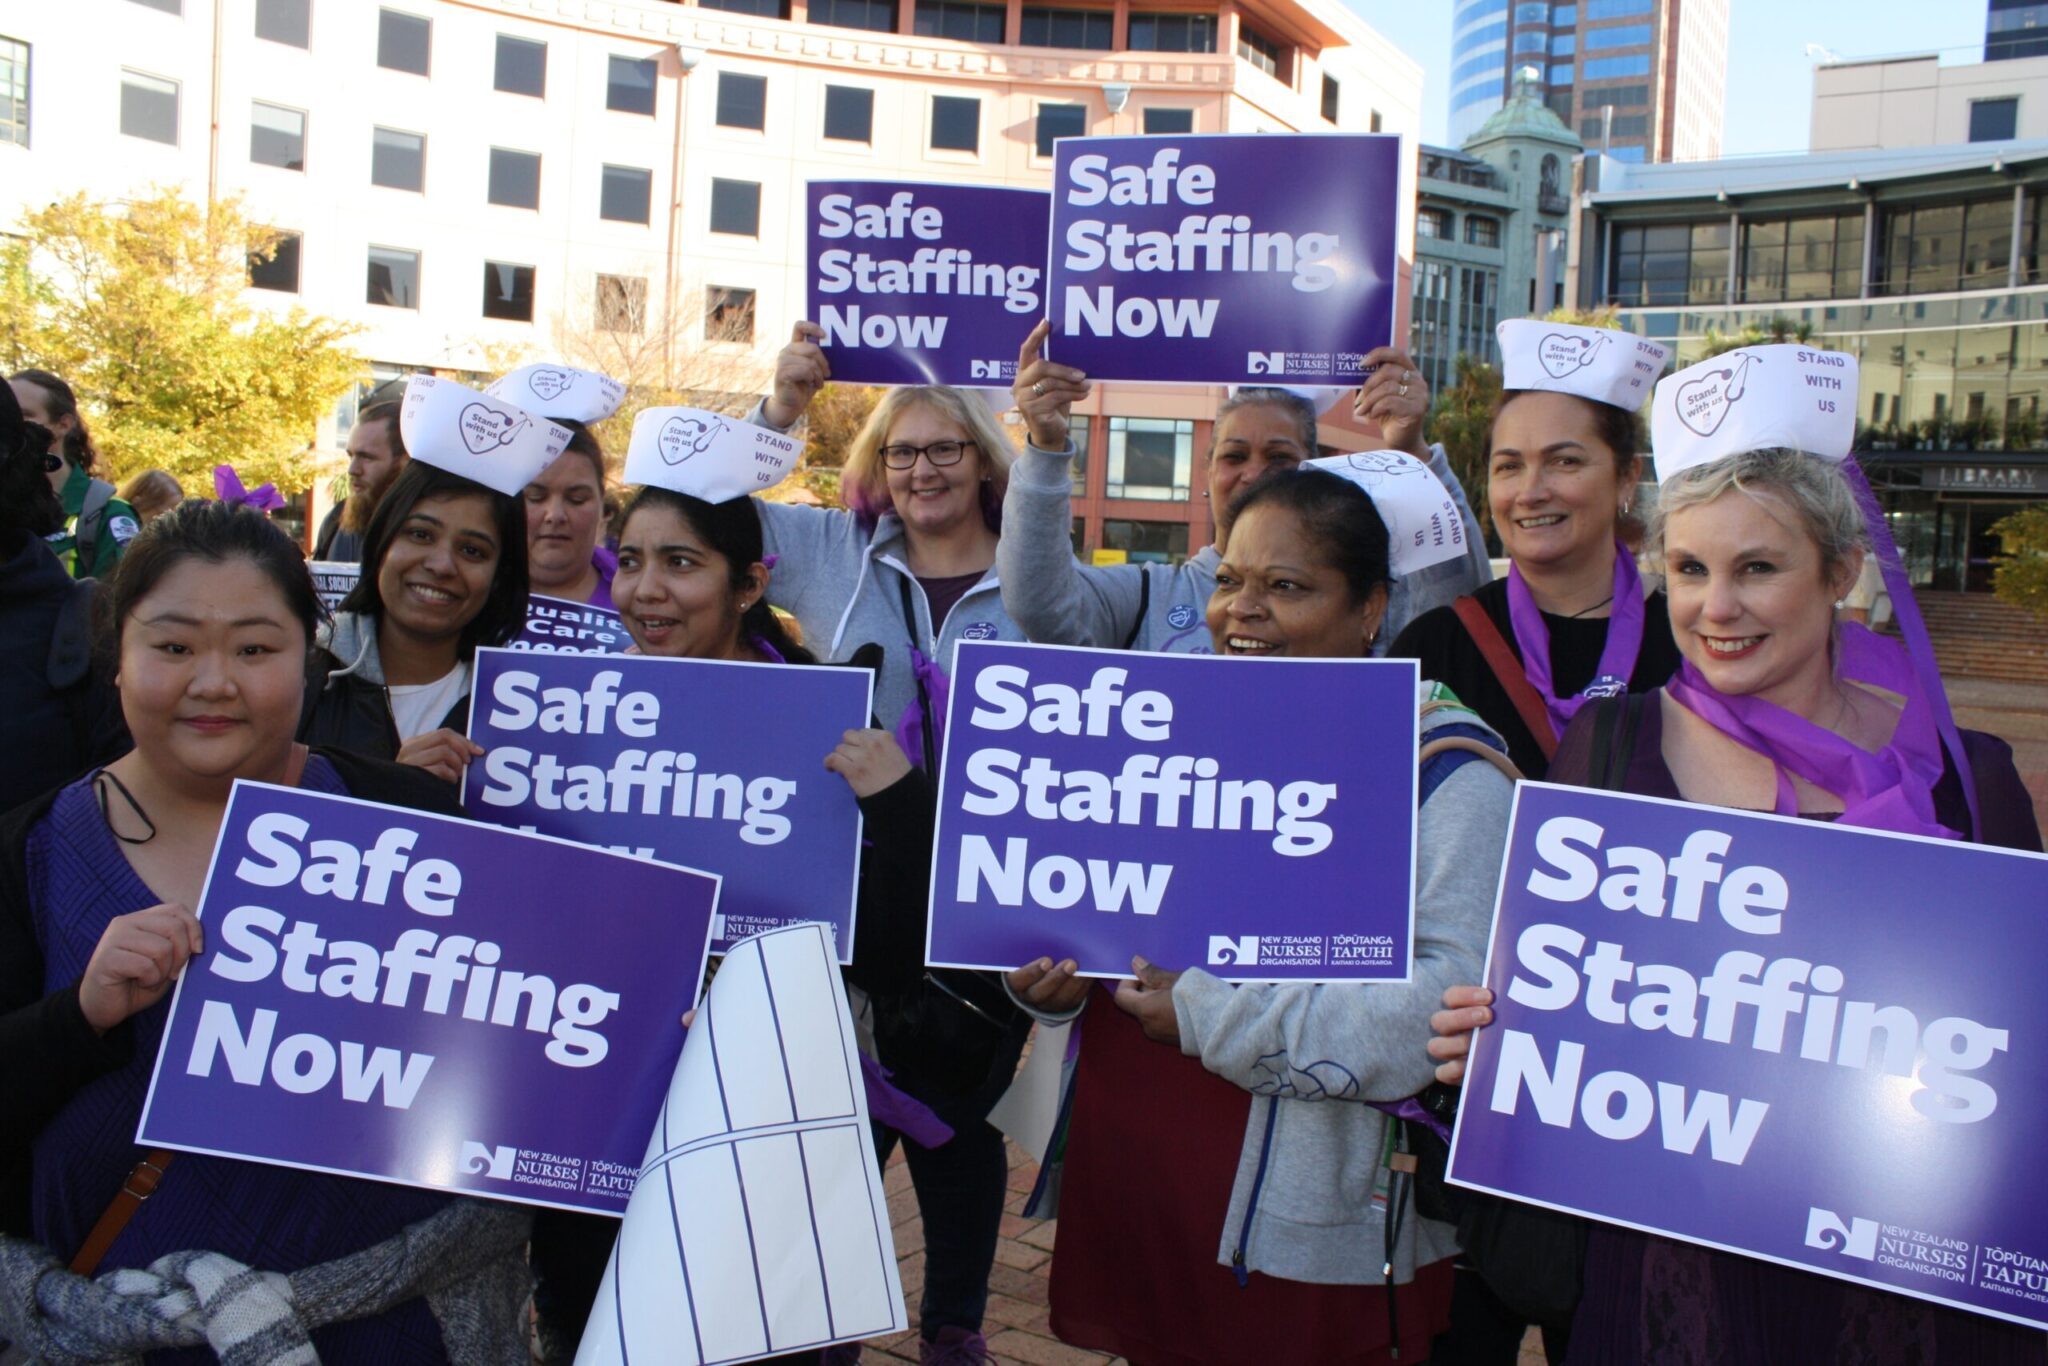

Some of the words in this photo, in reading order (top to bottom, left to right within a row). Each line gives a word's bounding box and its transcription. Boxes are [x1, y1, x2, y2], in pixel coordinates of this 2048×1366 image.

[1067, 148, 1216, 206] Safe
[818, 192, 943, 239] Safe
[1064, 215, 1339, 292] Staffing
[818, 248, 1040, 314] Staffing
[1064, 285, 1220, 339] Now
[819, 305, 948, 349] Now
[1545, 352, 1565, 360] with
[1550, 344, 1576, 353] Stand
[1636, 342, 1664, 358] STAND
[1286, 360, 1330, 369] NURSES
[1634, 360, 1654, 373] WITH
[1797, 351, 1845, 367] STAND
[599, 377, 621, 393] STAND
[1630, 379, 1642, 387] US
[1805, 375, 1842, 390] WITH
[1687, 384, 1718, 406] Stand
[1686, 401, 1710, 418] with
[1711, 395, 1723, 406] us
[1818, 399, 1836, 413] US
[465, 421, 486, 435] with
[486, 430, 498, 439] us
[472, 413, 499, 429] Stand
[549, 427, 569, 442] STAND
[663, 435, 681, 445] with
[681, 439, 692, 447] us
[669, 426, 693, 437] Stand
[755, 432, 793, 452] STAND
[755, 451, 783, 468] WITH
[757, 471, 771, 483] US
[1940, 468, 2036, 483] LIBRARY
[1431, 513, 1444, 546] WITH
[1443, 501, 1461, 545] STAND
[1414, 530, 1425, 547] US
[527, 604, 629, 636] ualit
[526, 619, 617, 644] Care
[488, 670, 660, 738] Safe
[970, 664, 1174, 742] Safe
[481, 746, 796, 846] Staffing
[961, 747, 1337, 857] Staffing
[235, 812, 462, 917] Safe
[956, 834, 1174, 916] Now
[1526, 816, 1790, 935] Safe
[745, 916, 779, 925] ZEALAND
[1261, 936, 1281, 944] NEW
[1282, 936, 1322, 944] ZEALAND
[1260, 945, 1322, 957] NURSES
[1332, 946, 1393, 958] TAPUHI
[1260, 958, 1321, 966] ORGANISATION
[209, 905, 620, 1068] Staffing
[1507, 923, 2009, 1124] Staffing
[186, 999, 435, 1109] Now
[1490, 1028, 1770, 1166] Now
[518, 1150, 540, 1161] NEW
[540, 1153, 581, 1167] ZEALAND
[516, 1160, 580, 1181] NURSES
[514, 1174, 577, 1191] ORGANISATION
[589, 1172, 637, 1191] TAPUH
[1881, 1224, 1912, 1239] NEW
[1911, 1230, 1969, 1252] ZEALAND
[1880, 1237, 1968, 1270] NURSES
[1877, 1254, 1965, 1283] ORGANISATION
[1980, 1280, 2014, 1297] KAITIAKI
[2015, 1288, 2024, 1298] O
